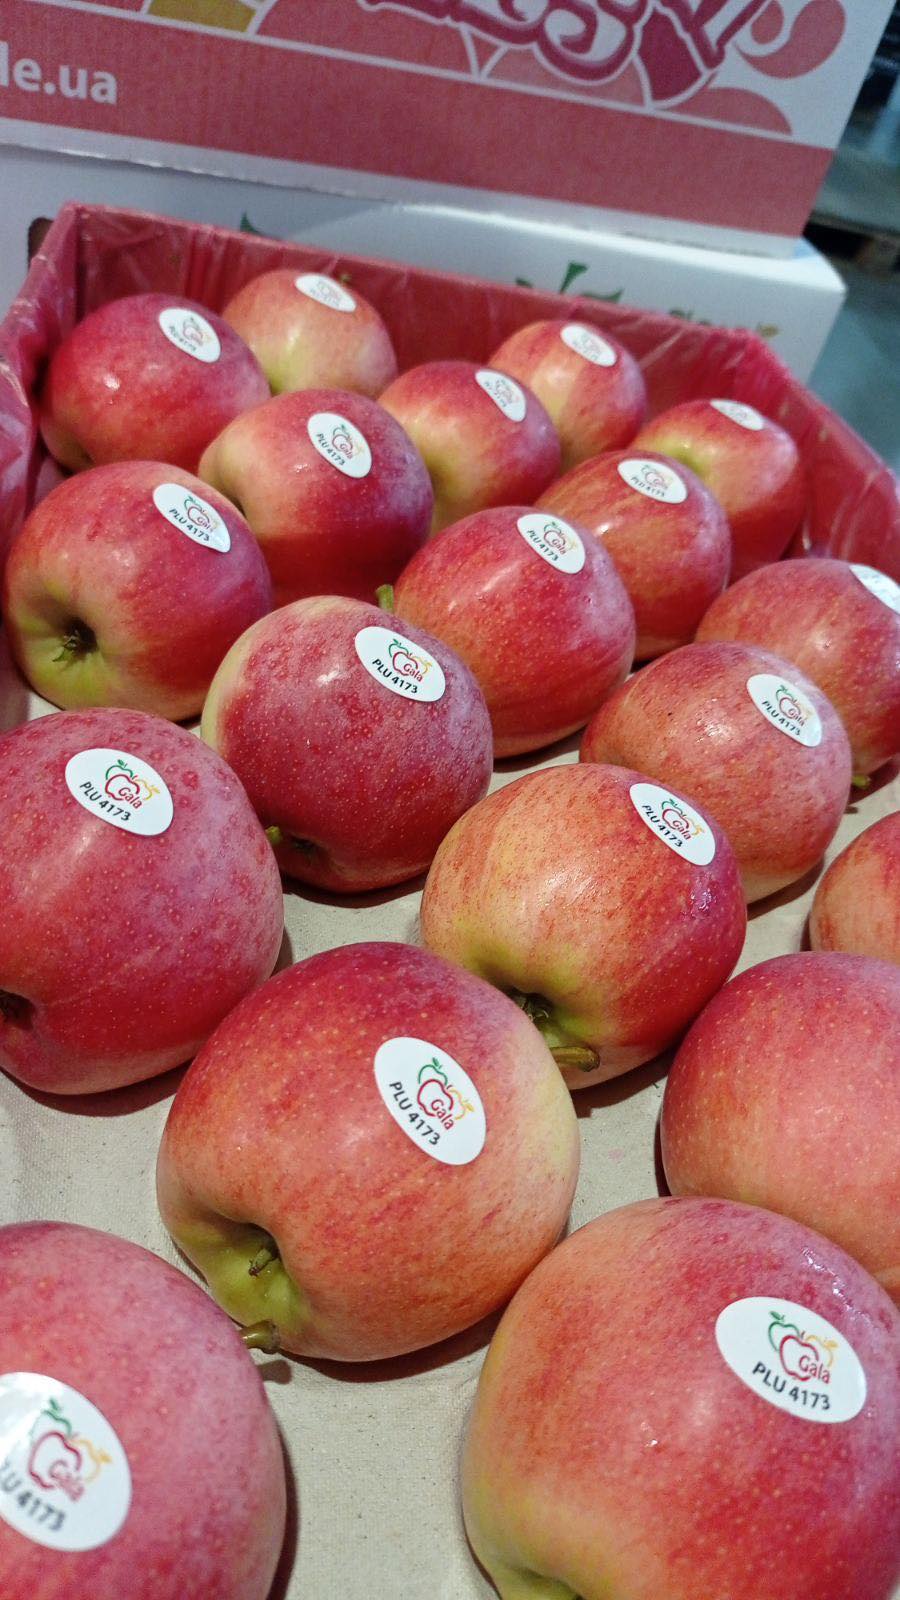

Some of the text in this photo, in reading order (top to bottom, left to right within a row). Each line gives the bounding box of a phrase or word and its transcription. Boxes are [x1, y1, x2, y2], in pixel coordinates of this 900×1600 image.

[327, 448, 345, 466] 4173
[169, 508, 209, 541] PLU 4173
[527, 529, 559, 561] PLU 4173
[372, 658, 418, 694] PLU 4173
[403, 663, 423, 682] Gala
[762, 700, 801, 736] PLU 4173
[80, 781, 131, 821] PLU 4173
[118, 787, 142, 809] Gala
[642, 804, 683, 847] PLU 4173
[672, 820, 691, 840] Gala
[389, 1081, 441, 1145] PLU 4173
[431, 1099, 454, 1130] Gala
[799, 1355, 831, 1384] Gala
[752, 1361, 831, 1411] PLU 4173
